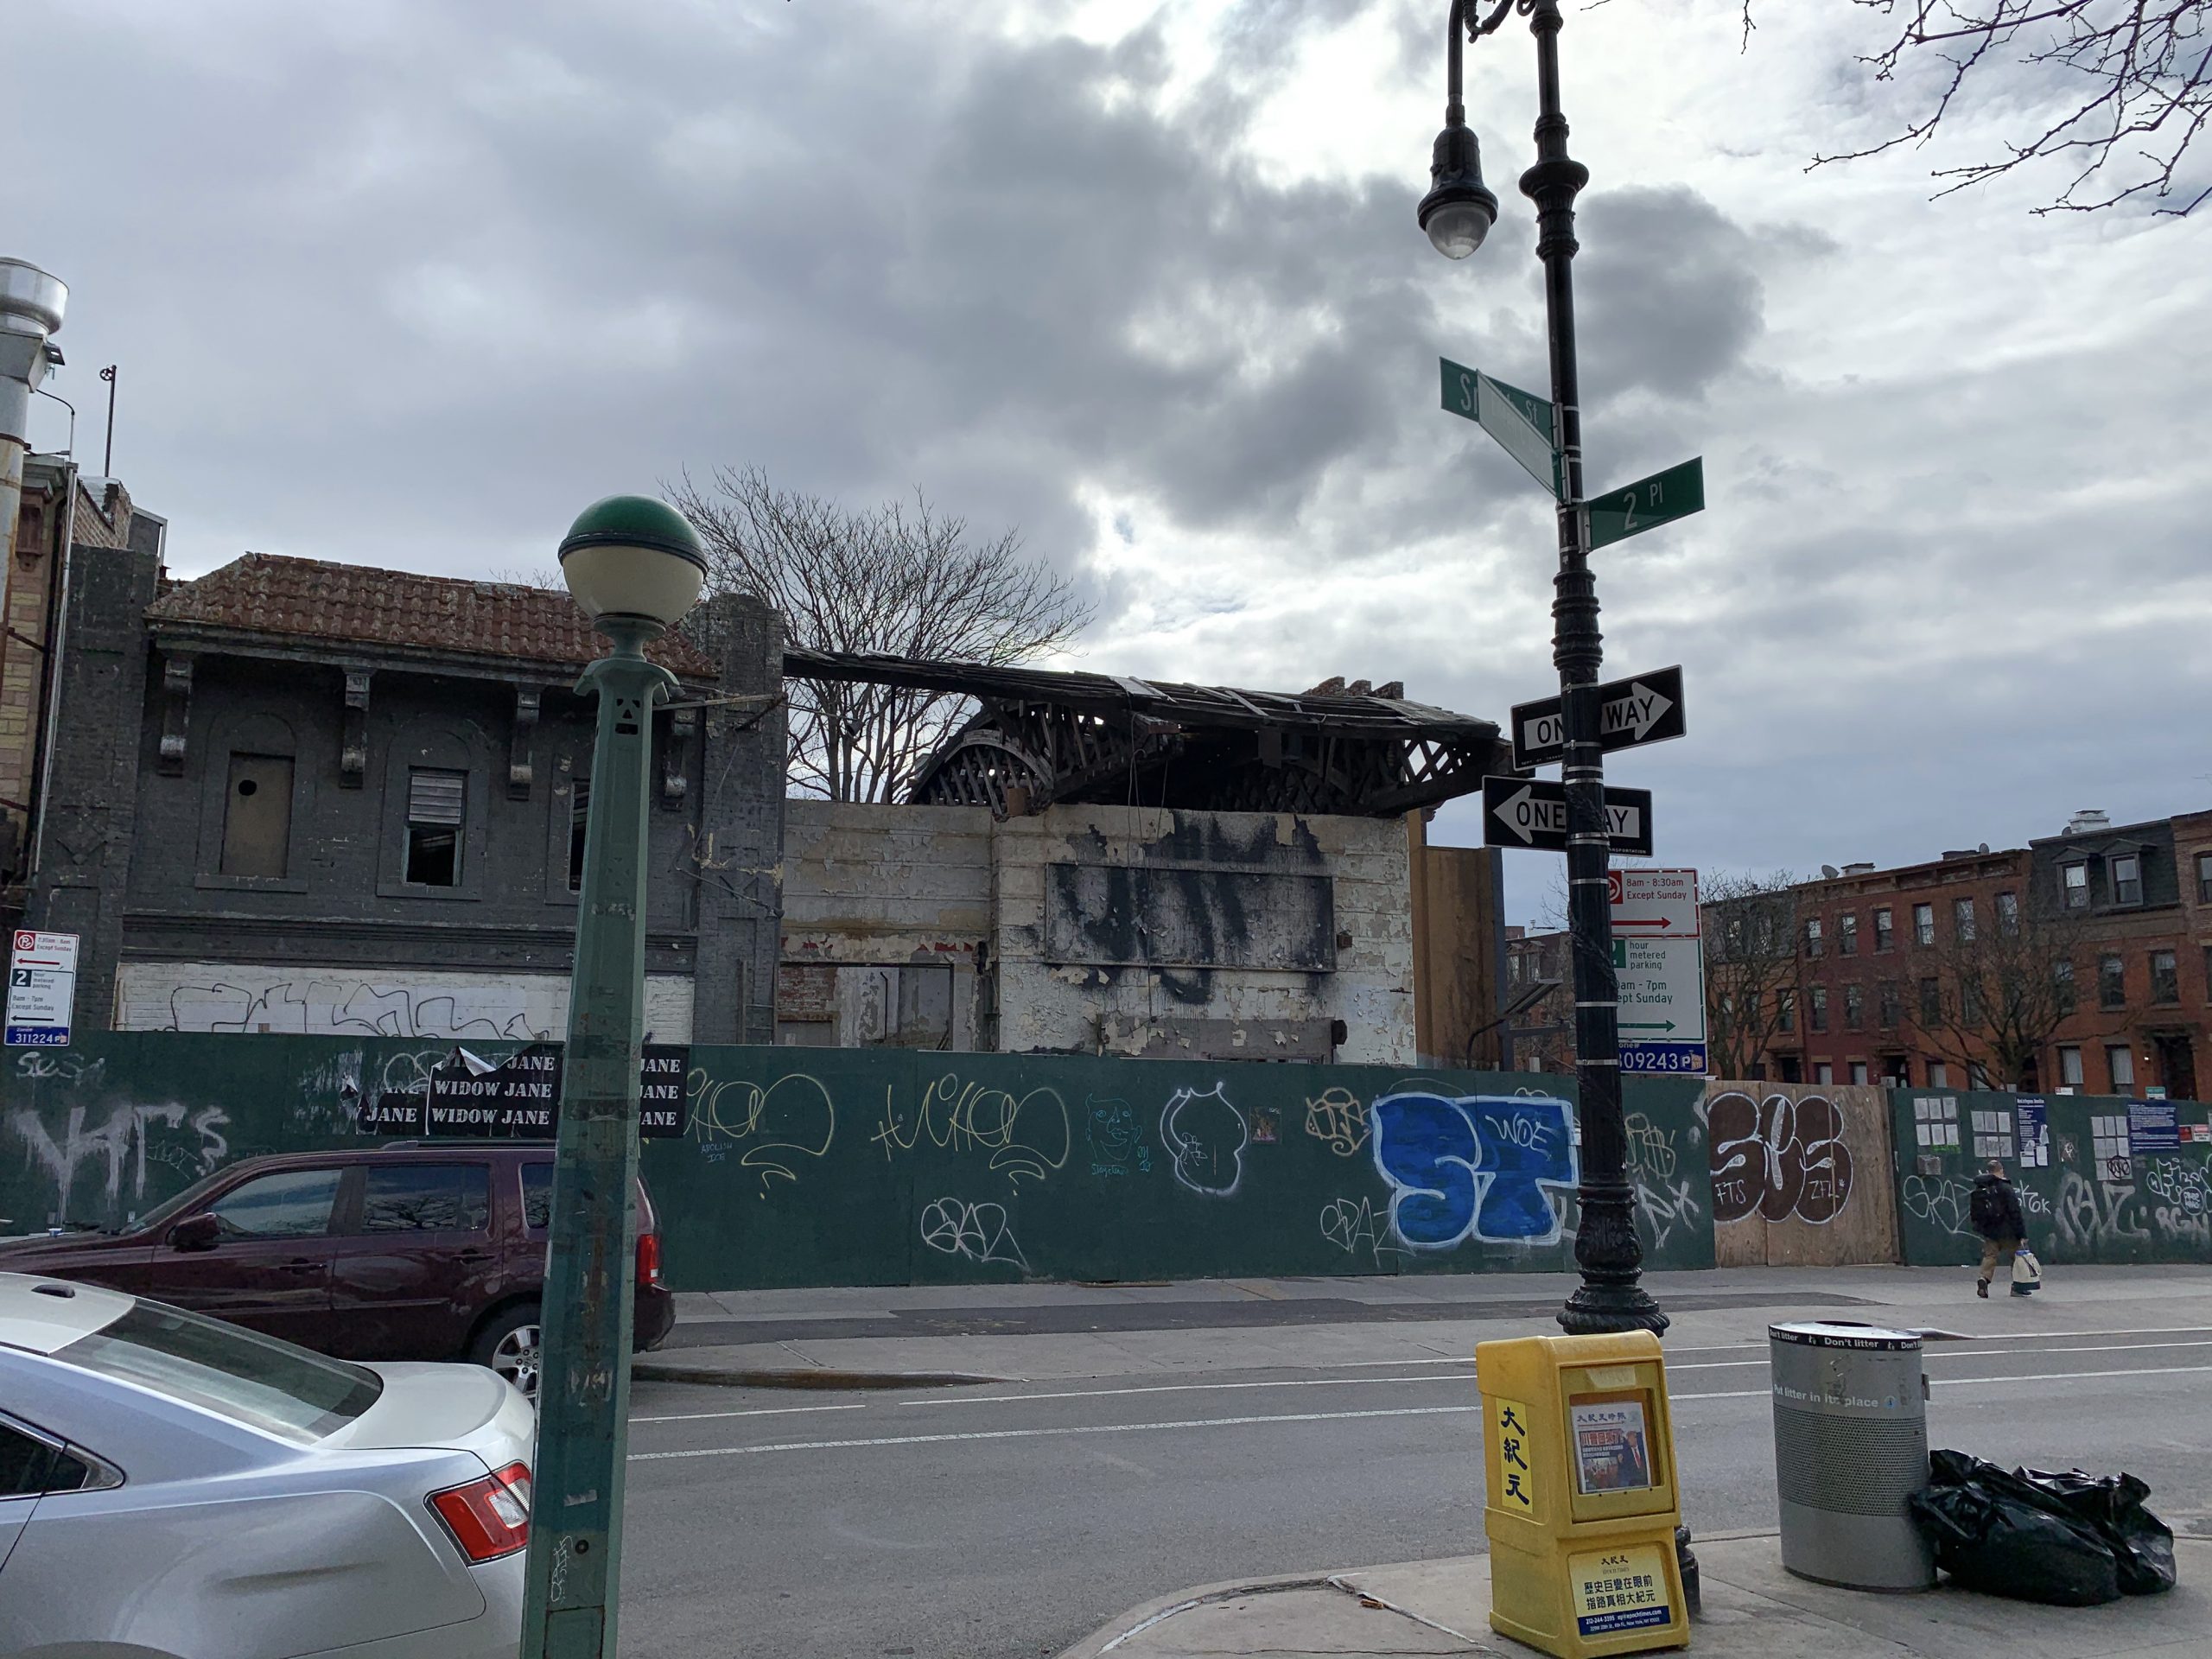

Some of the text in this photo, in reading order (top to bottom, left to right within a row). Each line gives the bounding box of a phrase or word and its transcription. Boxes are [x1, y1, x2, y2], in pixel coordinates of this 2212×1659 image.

[1623, 481, 1663, 531] 2 Pl
[1537, 695, 1655, 744] ON WAY
[1516, 801, 1629, 833] ONE AY
[1652, 878, 1684, 887] 8:30am
[1627, 891, 1687, 900] Except Sunday
[1630, 941, 1649, 950] hour
[1630, 961, 1662, 970] parking
[16, 970, 27, 985] 2
[1646, 980, 1667, 992] 7pm
[1618, 993, 1673, 1004] ept Sunday
[16, 1033, 53, 1044] 311224
[506, 1056, 556, 1071] JANE
[435, 1079, 501, 1096] WIDOW
[504, 1083, 553, 1098] JANE
[366, 1108, 417, 1122] JANE
[432, 1108, 550, 1125] WIDOW JANE
[639, 1111, 677, 1126] ANE
[1714, 1179, 1747, 1205] FTS
[1782, 1332, 1798, 1341] litter
[1824, 1338, 1878, 1348] Don't litter
[1774, 1383, 1783, 1395] Put
[1784, 1387, 1807, 1400] litter
[1809, 1392, 1821, 1402] in
[1845, 1396, 1878, 1408] place
[1500, 1406, 1530, 1505] 大紀元
[1584, 1574, 1653, 1595] 歷史巨變在眼前
[1586, 1590, 1656, 1611] 指路真相大紀元
